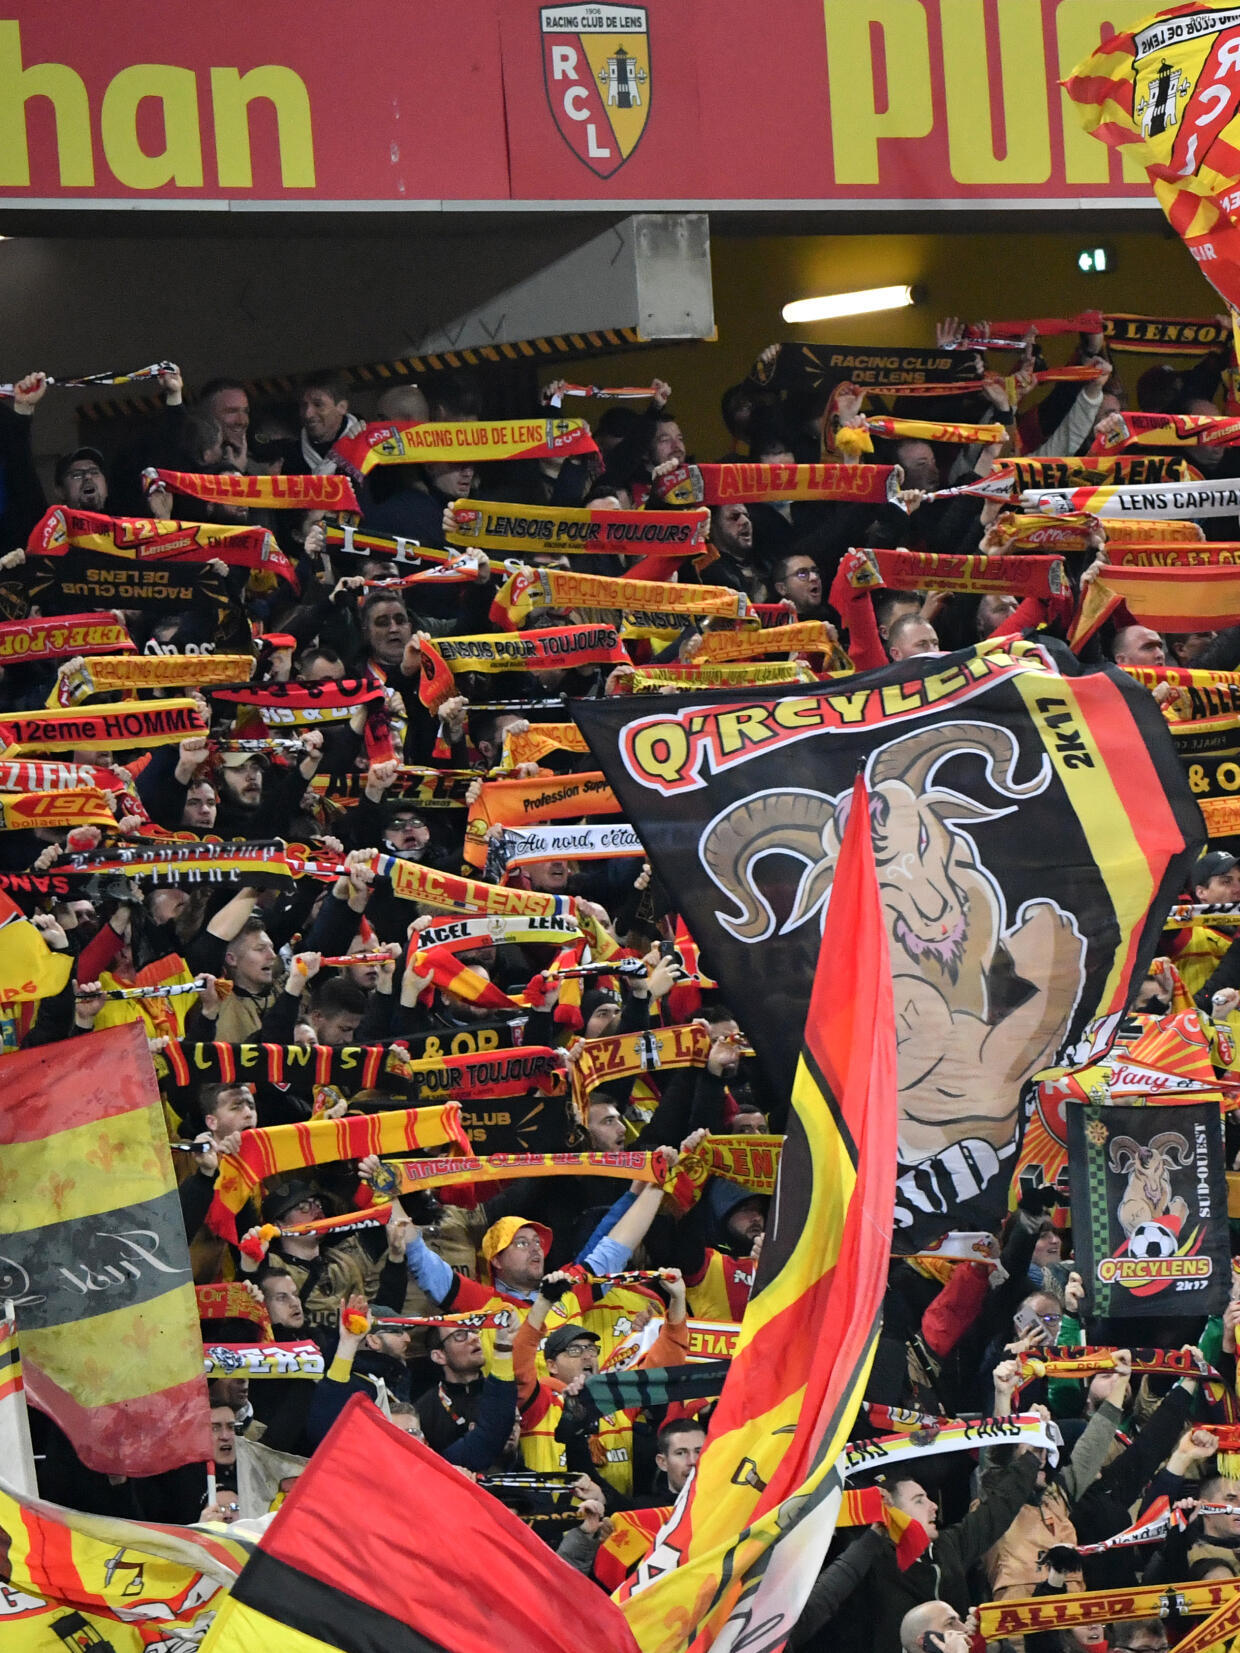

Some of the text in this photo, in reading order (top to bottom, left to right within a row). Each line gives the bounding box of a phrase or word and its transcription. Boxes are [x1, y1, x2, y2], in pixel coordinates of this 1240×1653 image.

[546, 16, 642, 28] RACING CLUB DE LENS
[830, 354, 952, 371] RACING CLUB
[852, 370, 926, 384] DE LENS
[404, 424, 543, 448] RACING CLUB DE LENS
[719, 464, 877, 498] ALLEZ LENS
[1113, 457, 1187, 486] LENS
[178, 472, 345, 502] ALLEZ LENS
[1119, 491, 1168, 512] LENS
[121, 520, 154, 542] 12
[485, 514, 693, 544] LENSOIS POUR TOUJOURS
[140, 536, 191, 557] Lensois
[62, 582, 193, 600] RACING CLUB
[86, 568, 170, 585] DE LENS
[555, 575, 688, 602] RACING CLUB DE
[495, 628, 617, 660] POUR TOUJOURS
[12, 708, 207, 743] 12eme HOMME
[27, 764, 97, 792] LENS
[1188, 764, 1210, 794] &
[522, 776, 612, 813] Profession Supp
[516, 833, 548, 855] Au
[400, 862, 552, 917] R.C. LENS
[418, 921, 472, 951] XCEL
[193, 1041, 362, 1071] LENS
[424, 1029, 500, 1059] & OR
[469, 1056, 554, 1087] TOUJOURS
[460, 1112, 511, 1126] CLUB
[1194, 1122, 1212, 1218] SUD-OUEST
[993, 1597, 1136, 1634] ALLEZ
